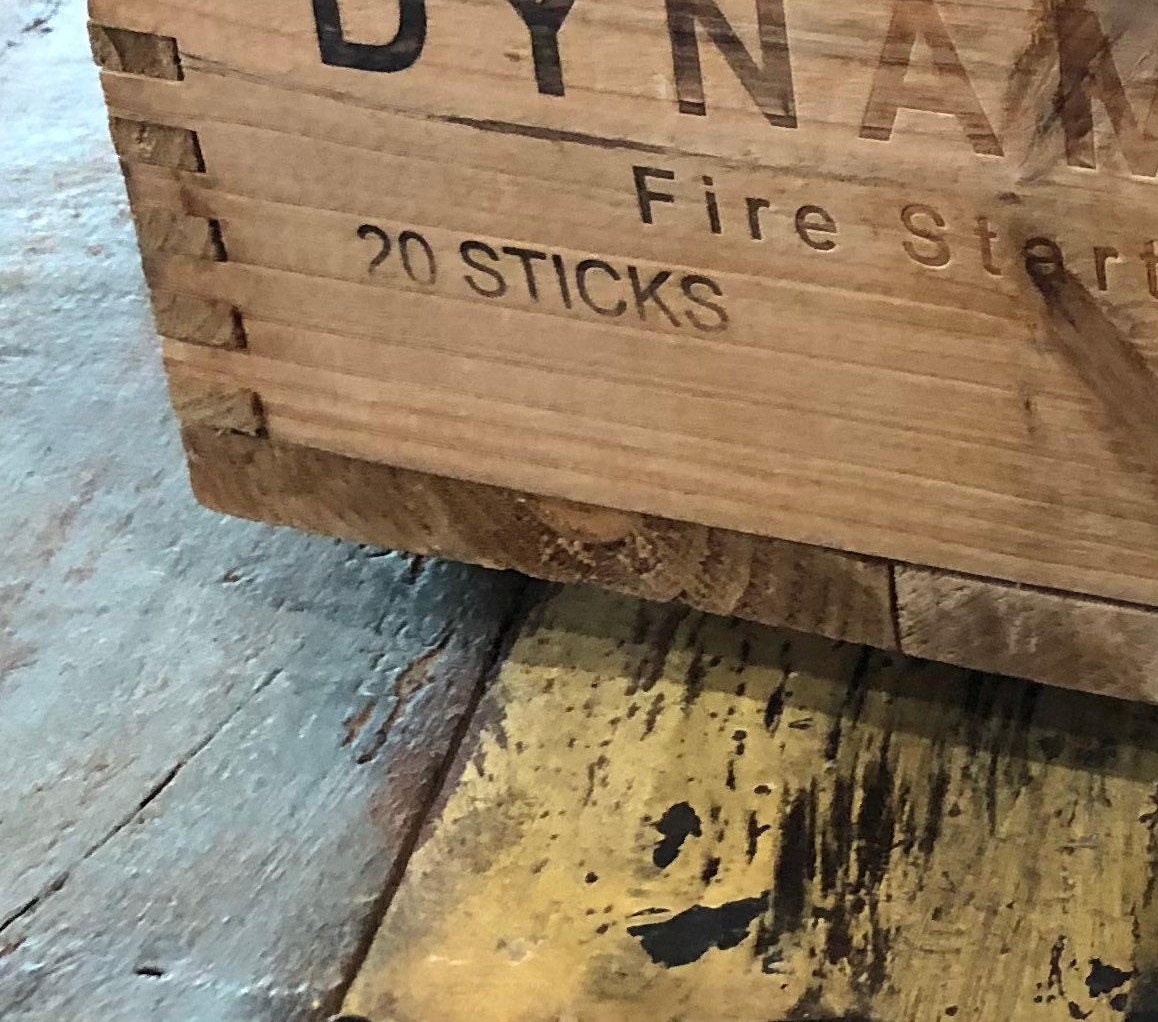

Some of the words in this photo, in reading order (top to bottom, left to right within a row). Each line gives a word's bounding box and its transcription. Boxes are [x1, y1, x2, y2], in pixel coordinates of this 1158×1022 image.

[631, 165, 838, 252] Fire
[357, 223, 438, 286] 20
[458, 238, 731, 333] STICKS
